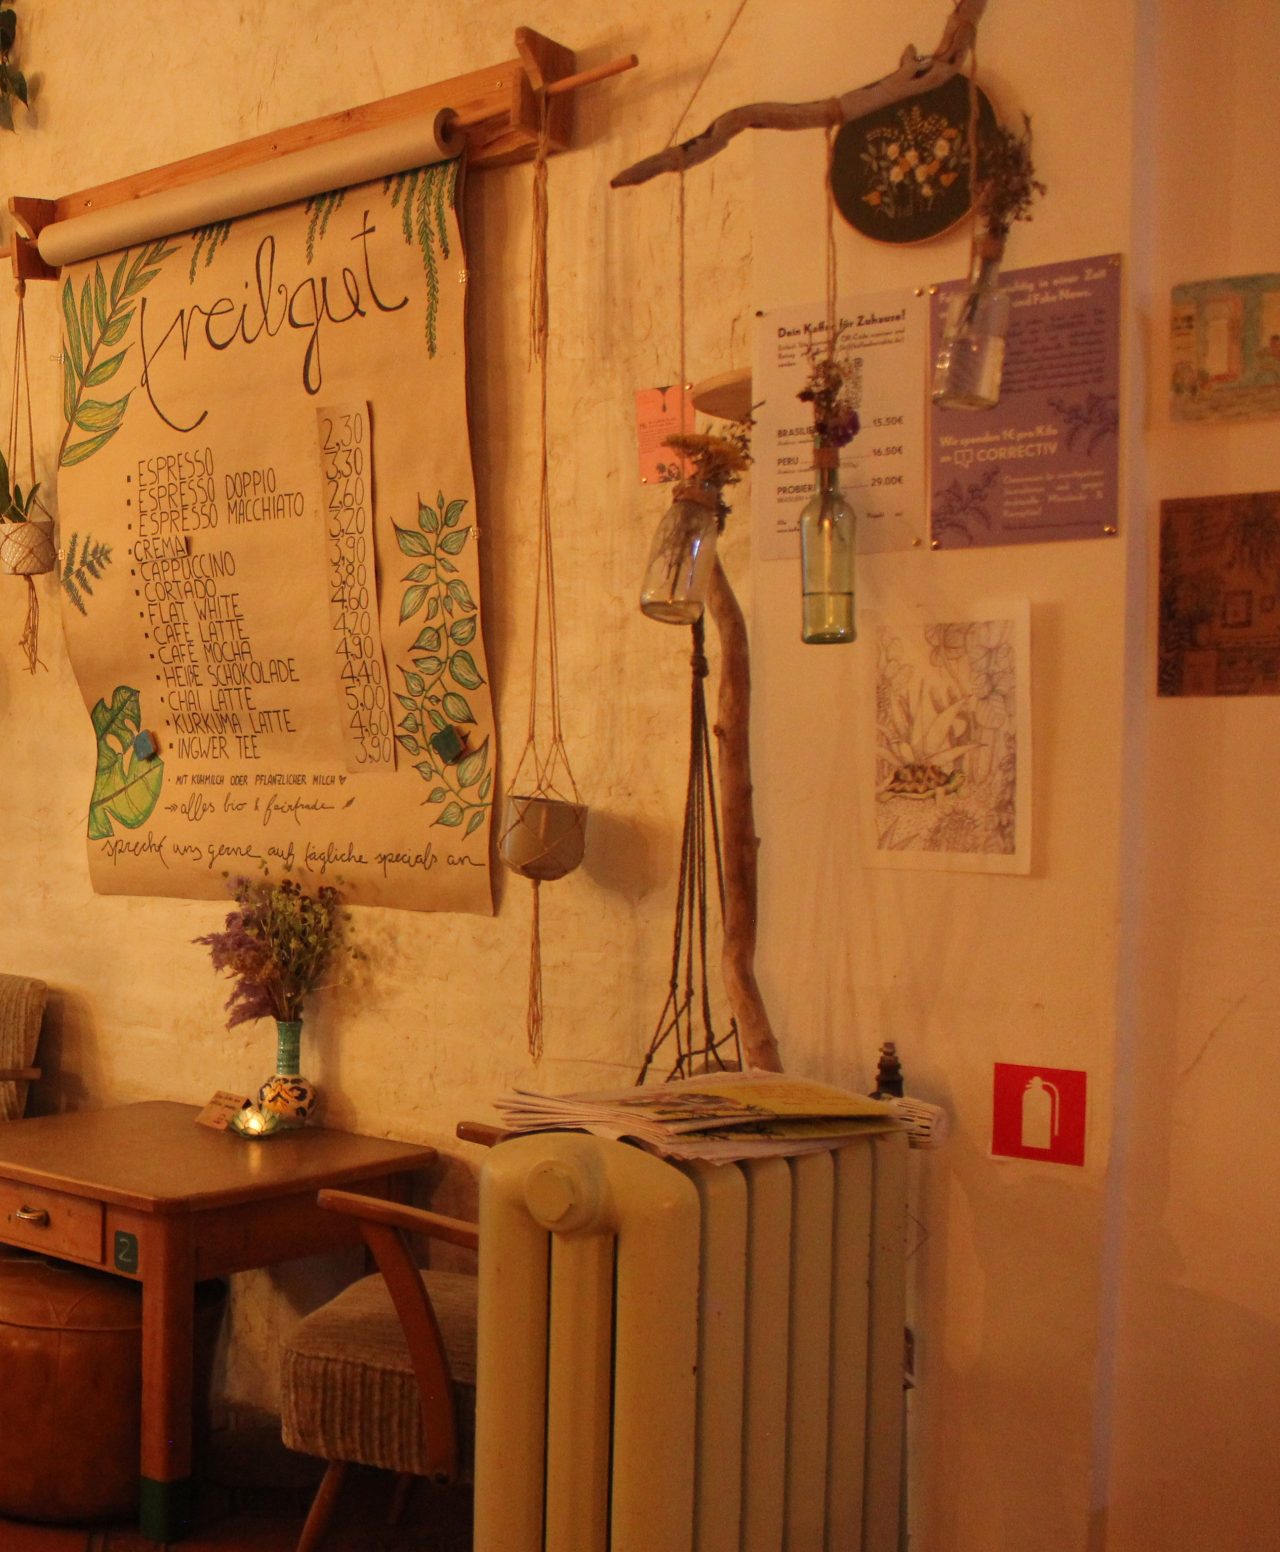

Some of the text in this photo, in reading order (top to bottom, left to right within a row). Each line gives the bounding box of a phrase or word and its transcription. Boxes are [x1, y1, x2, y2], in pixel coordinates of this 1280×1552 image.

[777, 327, 801, 338] Dein
[839, 317, 853, 329] für
[857, 308, 906, 327] Zuhause!
[321, 412, 363, 450] 2,30
[777, 426, 817, 438] BRASILIE
[324, 446, 364, 480] 3,30
[777, 457, 799, 467] PERU
[976, 441, 1059, 462] CORRECTIV
[138, 446, 214, 487] ESPRESSO
[138, 467, 277, 514] ESPRESSO DOPPIO
[327, 476, 365, 509] 2,60
[777, 484, 817, 496] PROBIER
[139, 491, 305, 537] ESPRESSO MACCHIATO
[328, 506, 366, 539] 3,20
[133, 535, 186, 562] CREMA
[329, 535, 366, 566] 3,90
[140, 550, 236, 582] CAPPUCCINO
[330, 563, 367, 590] 3,80
[144, 578, 217, 603] CORTADO
[330, 586, 369, 613] 4,60
[147, 593, 244, 625] FLAT WHITE
[198, 618, 251, 643] LATTE
[332, 610, 371, 638] 4,20
[203, 640, 253, 664] MOCHA
[335, 634, 374, 661] 4,90
[207, 657, 300, 687] SCHOKOLADE
[340, 659, 382, 687] 4,40
[168, 686, 257, 712] CHAI LATTE
[345, 684, 386, 712] 5,00
[172, 708, 297, 735] KURKUMA LATTE
[177, 734, 261, 760] INGWER TEE
[352, 734, 392, 764] 3,90
[175, 774, 336, 786] MIT KUHMILCH ODER PFLANZLICHER MILCH
[180, 791, 216, 822] alles
[223, 791, 248, 813] bio
[263, 792, 335, 827] fairtrade
[172, 842, 203, 862] uns
[207, 843, 262, 870] gerne
[267, 841, 295, 871] auf
[373, 841, 439, 879] specials
[446, 852, 486, 867] an
[119, 1238, 132, 1262] 2
